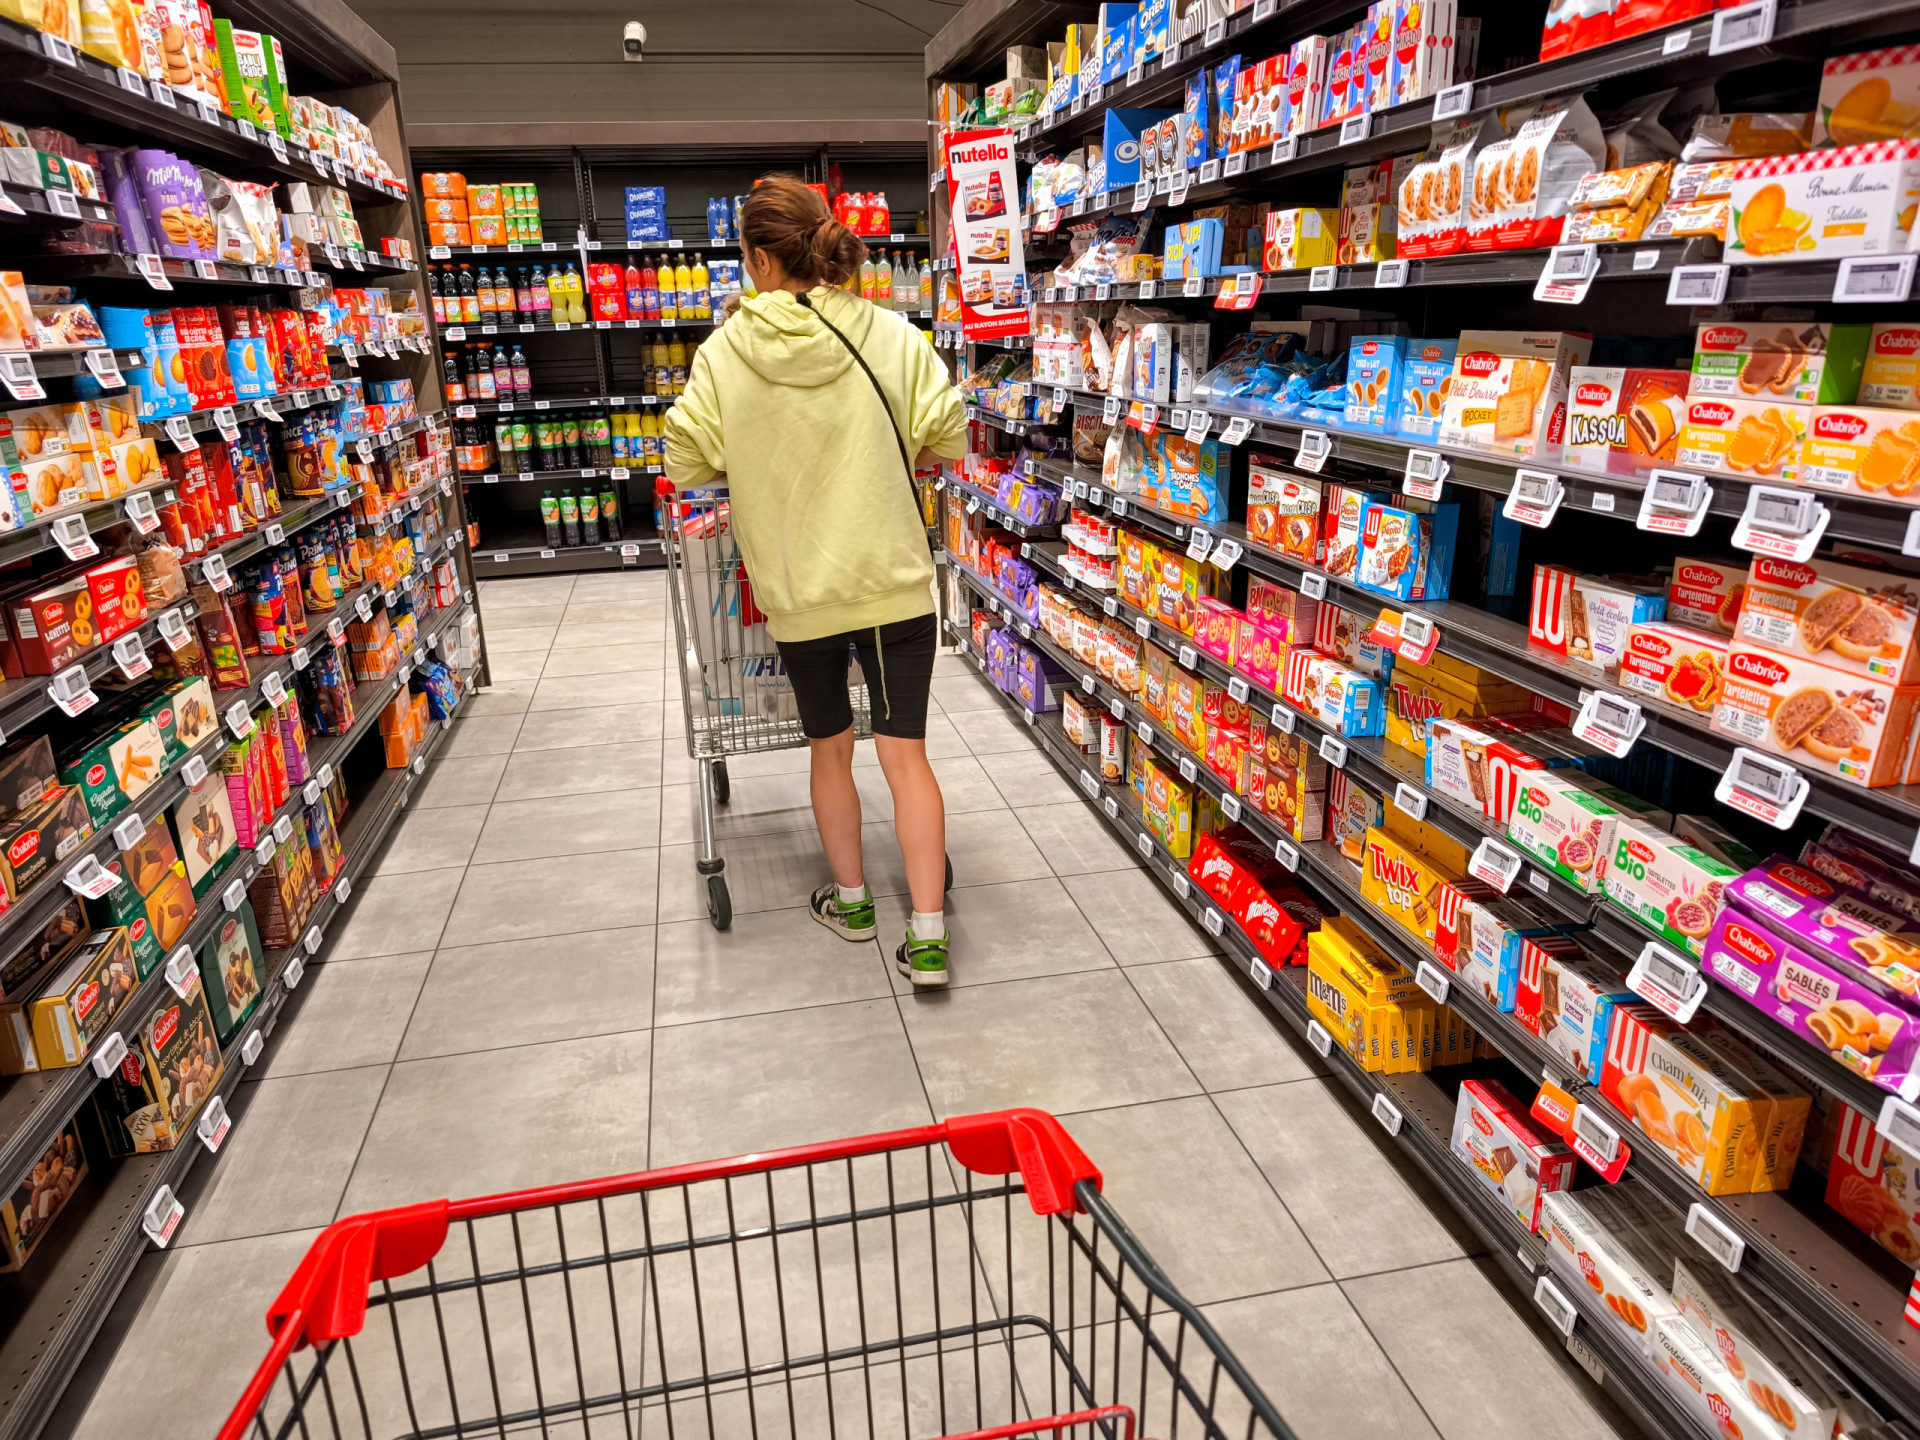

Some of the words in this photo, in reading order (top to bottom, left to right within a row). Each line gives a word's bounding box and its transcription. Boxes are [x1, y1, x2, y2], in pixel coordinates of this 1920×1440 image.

[1106, 34, 1125, 64] OREO
[1367, 41, 1392, 61] MIKADO
[1396, 29, 1422, 51] MIKADO
[1079, 56, 1101, 92] OREO
[1288, 76, 1308, 91] MIKADO
[1049, 74, 1071, 112] OREO
[951, 143, 1008, 164] nutella
[965, 182, 987, 192] nutella
[1805, 174, 1842, 199] Bonne
[1844, 170, 1888, 194] Maman
[1826, 204, 1868, 222] Tartelettes
[970, 231, 992, 239] nutella
[962, 277, 980, 285] nutella
[963, 322, 974, 331] AU
[975, 319, 998, 329] RAYON
[998, 316, 1028, 327] SURGELÉ
[1705, 328, 1744, 346] Chabrior
[1879, 334, 1920, 349] Chabrio
[1463, 356, 1498, 372] Chabrior
[1450, 379, 1469, 397] Petit
[1468, 381, 1498, 400] Beurre
[1578, 387, 1609, 402] Chabrior
[1464, 410, 1492, 422] POCKET
[1692, 405, 1731, 421] Chabrior
[1571, 415, 1627, 445] KASSOA
[1818, 416, 1864, 436] Chabrior
[1328, 484, 1341, 515] LU
[1365, 511, 1380, 536] LU
[1381, 520, 1403, 537] Pépito
[1682, 567, 1720, 585] Chabrior
[1760, 558, 1812, 584] Chabrior
[1250, 586, 1264, 608] BN
[1531, 565, 1574, 647] LU
[1677, 587, 1716, 606] Tartelettes
[1749, 586, 1798, 611] Tartelettes
[1196, 609, 1209, 632] BN
[1588, 601, 1606, 617] Petit
[1315, 602, 1336, 652] LU
[1240, 633, 1254, 656] BN
[1634, 635, 1669, 654] Chabrior
[1628, 654, 1665, 676] Tartelettes
[1734, 654, 1785, 682] Chabrior
[1287, 651, 1310, 703] LU
[1204, 692, 1222, 714] BN
[1723, 681, 1771, 708] Tartelettes
[1108, 727, 1116, 756] nutella
[1251, 724, 1266, 747] BN
[1411, 720, 1425, 742] to
[1251, 771, 1265, 796] BN
[1517, 787, 1543, 824] Bio
[1530, 788, 1549, 808] Chabrior
[11, 833, 39, 860] Chabrior
[1630, 842, 1655, 864] Chabrior
[1202, 856, 1234, 879] Maltesers
[1613, 838, 1645, 881] Bio
[1647, 868, 1676, 891] TARTELETTES
[1779, 866, 1827, 897] Chabrior
[1387, 885, 1413, 911] top
[1438, 884, 1466, 934] LU
[1245, 899, 1280, 924] Maltesers
[1839, 902, 1892, 932] SABLÉS
[1729, 927, 1771, 961] Chabrior
[1520, 938, 1550, 994] LU
[1785, 962, 1831, 999] SABLÉS
[78, 984, 100, 1013] Chabrior
[153, 1008, 179, 1044] Chabrior
[1609, 1007, 1650, 1075] LU
[1651, 1051, 1711, 1111] Chamonix
[133, 1111, 151, 1137] MAXI
[1583, 1145, 1596, 1161] PRIX
[1595, 1156, 1608, 1170] BAS
[1578, 1255, 1596, 1273] TOP
[1717, 1332, 1736, 1352] TOP
[1658, 1331, 1704, 1385] Tartelettes
[1707, 1396, 1731, 1418] TOP
